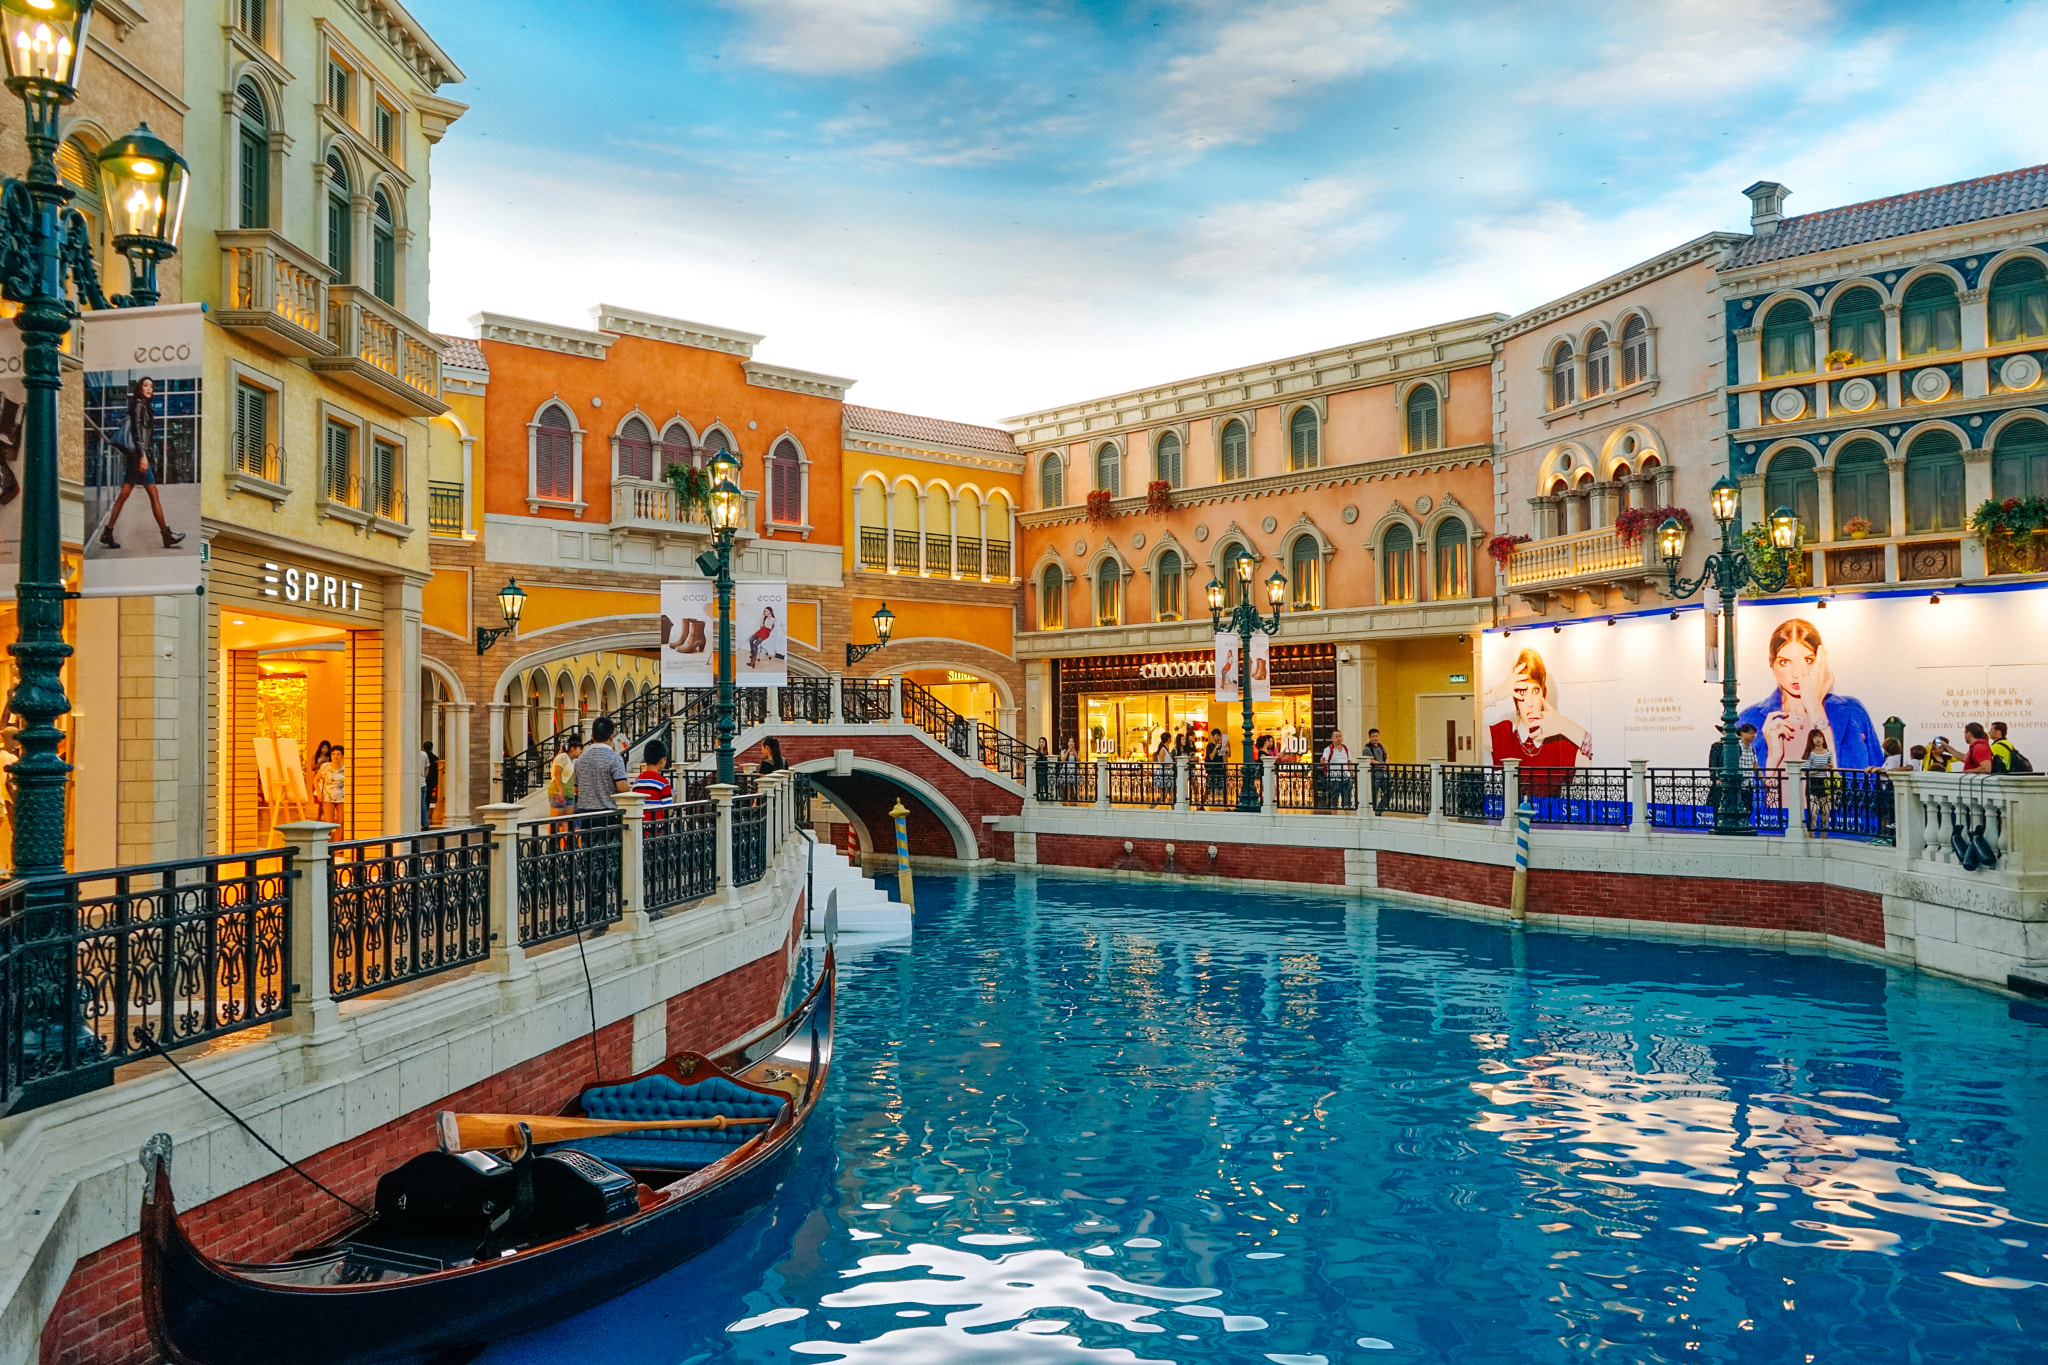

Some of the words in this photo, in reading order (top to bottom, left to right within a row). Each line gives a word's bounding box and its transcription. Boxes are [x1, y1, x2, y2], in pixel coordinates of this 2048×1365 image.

[134, 344, 191, 363] ecco
[265, 562, 363, 612] ESPRIT
[682, 594, 708, 602] ecco
[757, 594, 782, 602] ecco
[1942, 710, 1967, 718] OVER
[1987, 710, 2018, 718] SHOPS
[2019, 709, 2033, 717] OF
[1095, 738, 1115, 754] 100
